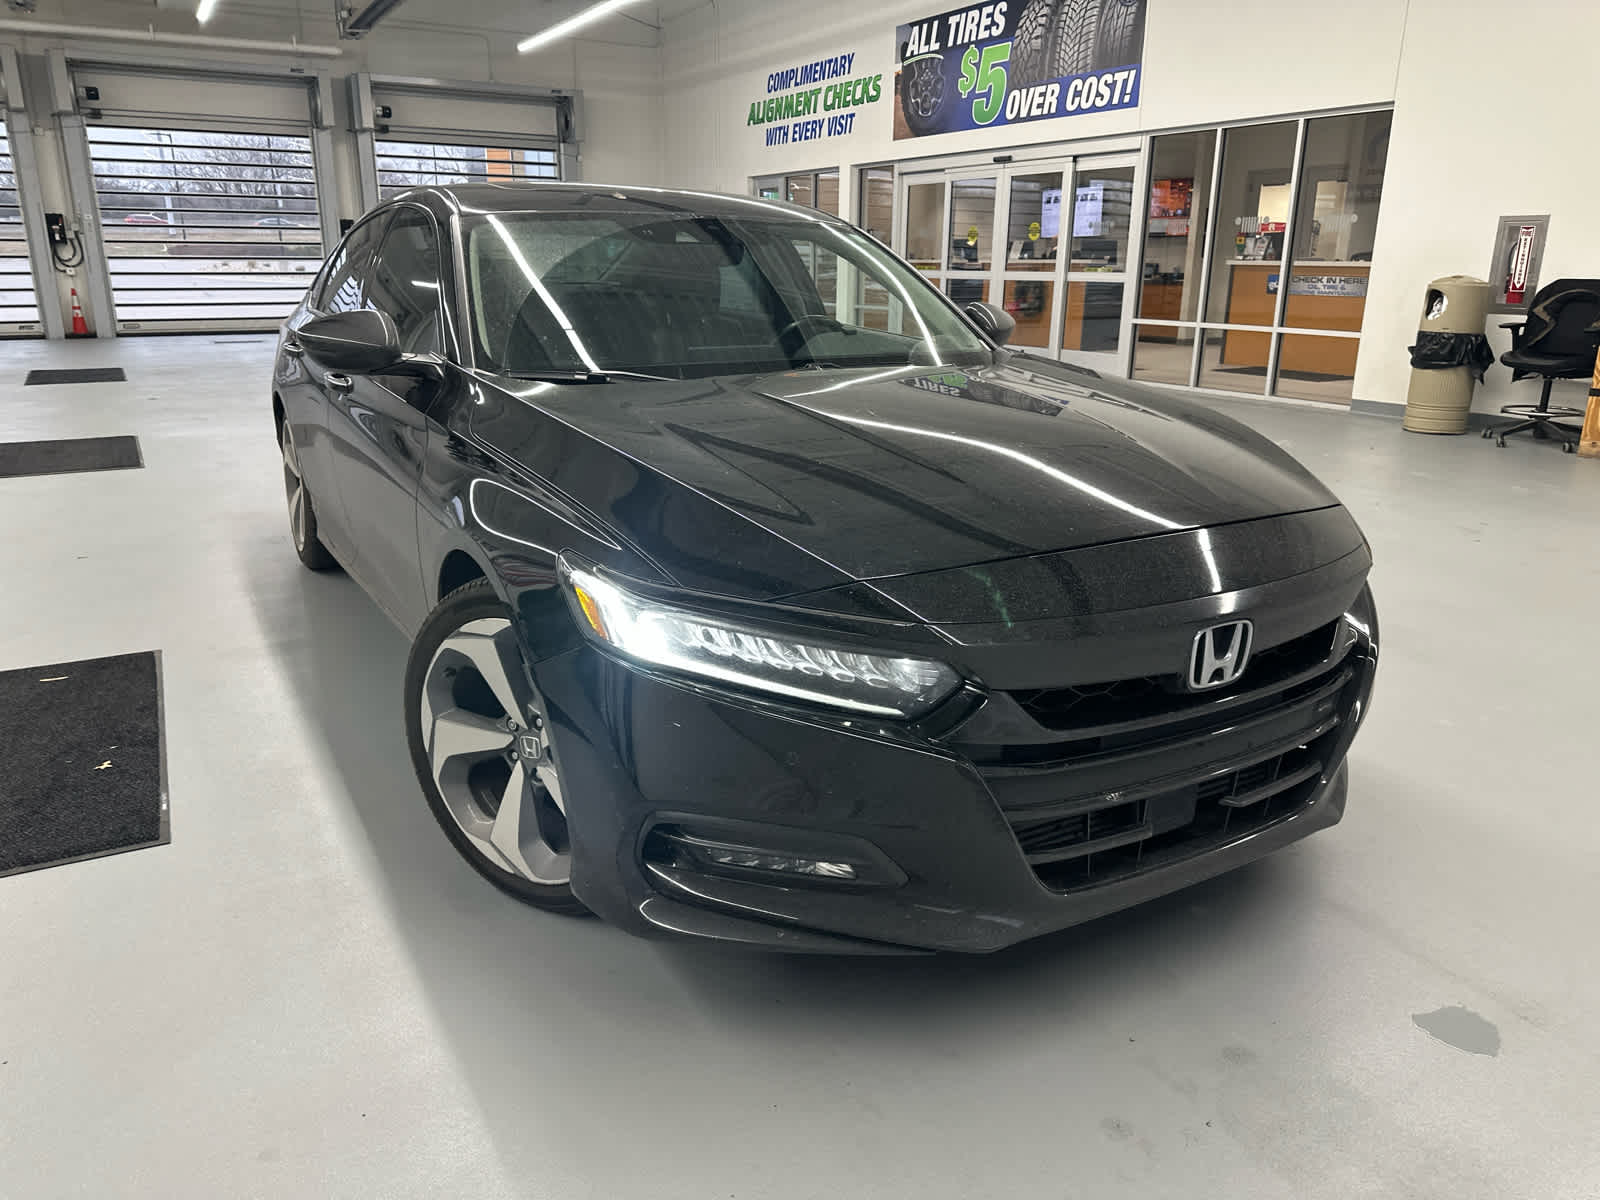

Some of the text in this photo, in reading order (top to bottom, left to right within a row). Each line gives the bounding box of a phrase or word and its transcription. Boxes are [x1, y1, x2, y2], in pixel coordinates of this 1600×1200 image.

[905, 1, 1008, 58] ALL TIRES
[767, 52, 855, 94] COMPLIMENTARY
[957, 41, 1012, 126] $5
[1005, 69, 1137, 121] OVER COST!
[747, 74, 882, 126] ALIGNMENT CHECKS
[766, 113, 856, 147] WITH EVERY VISIT
[1326, 276, 1337, 284] IN
